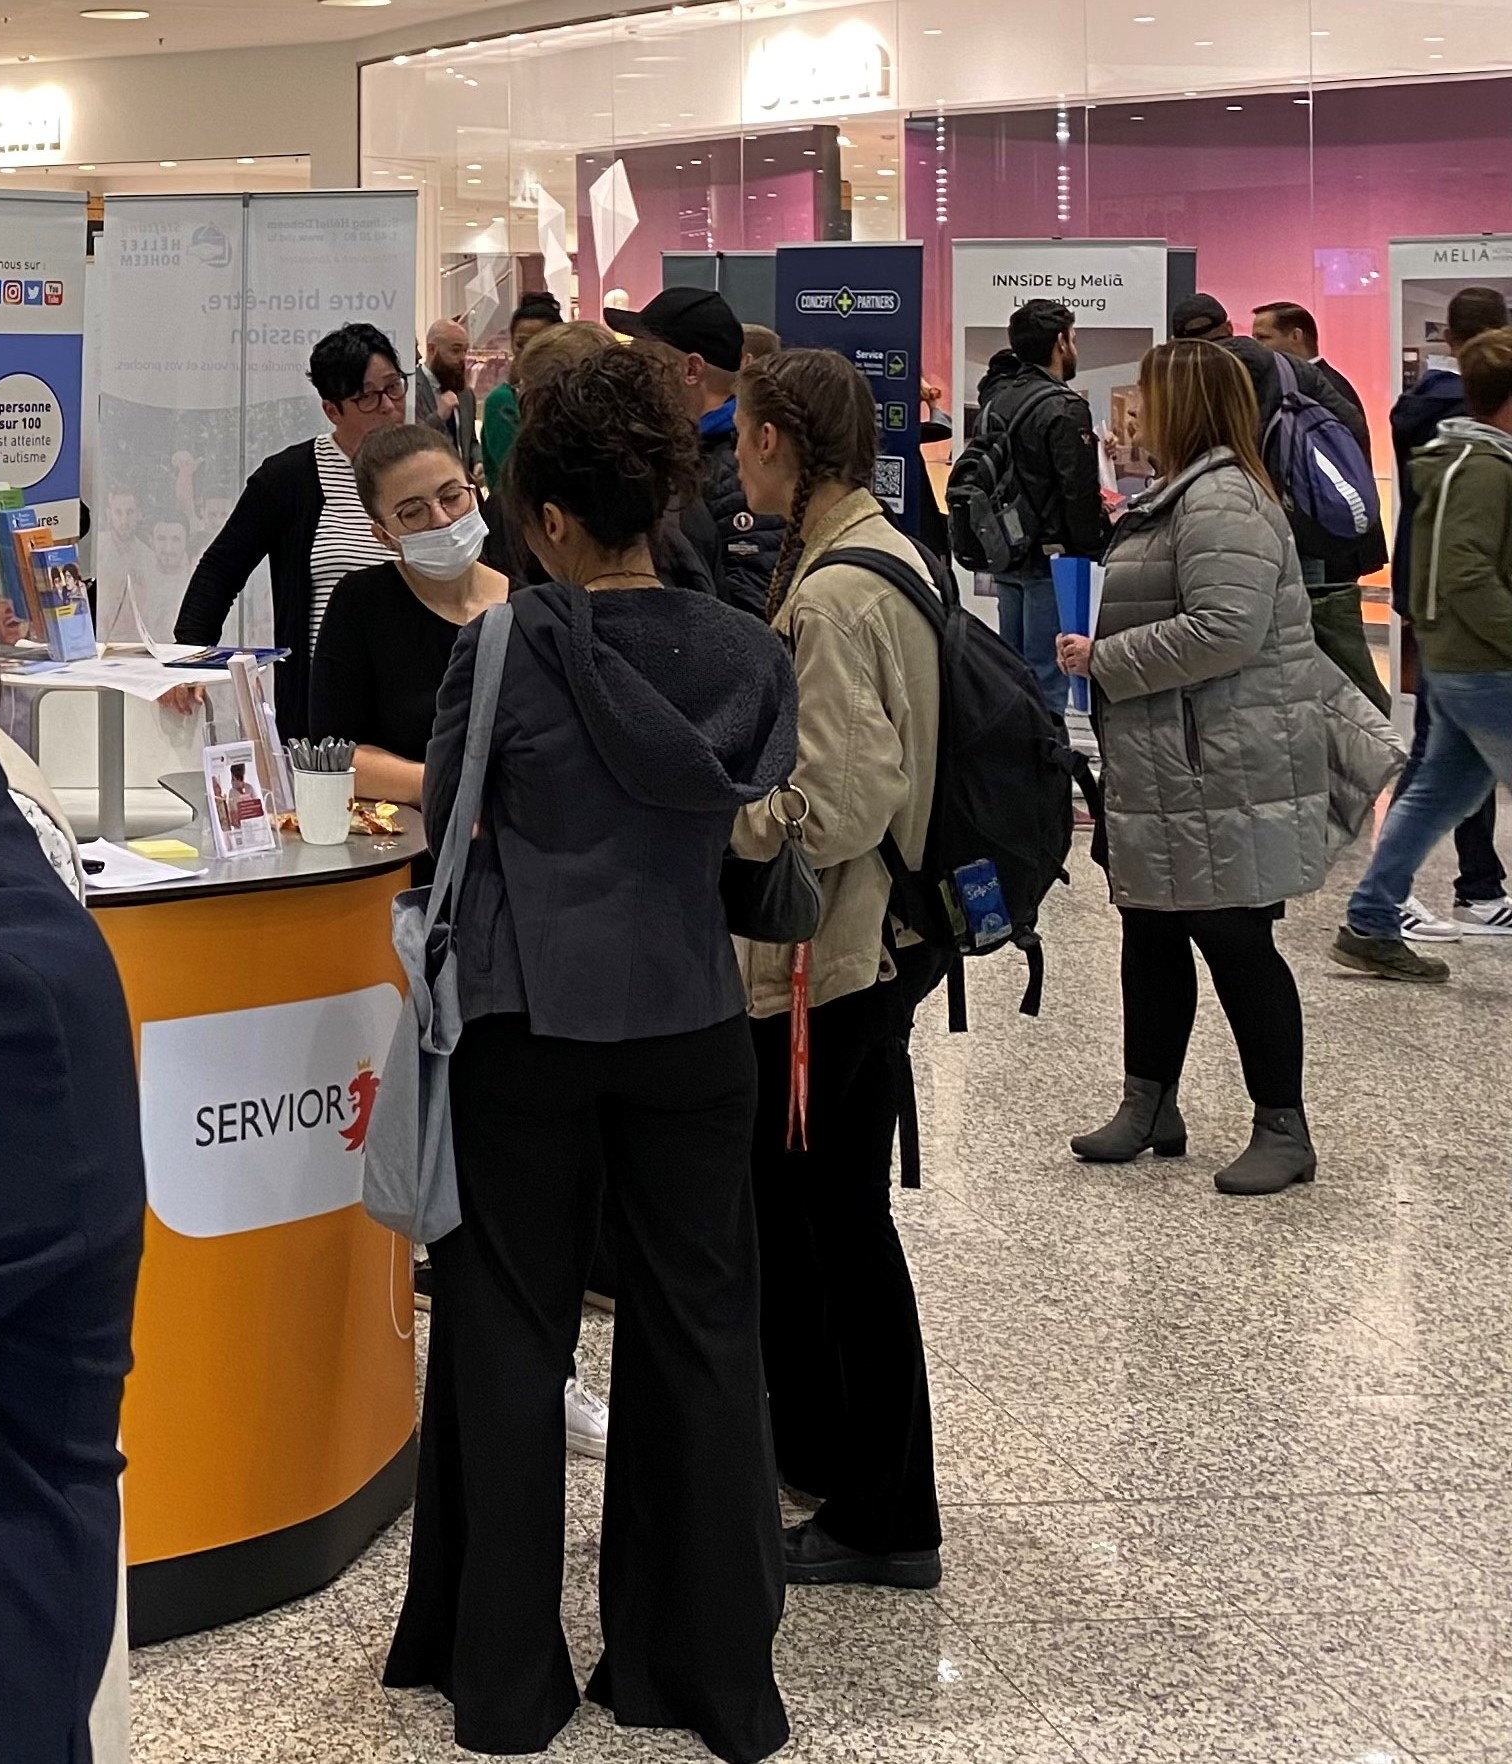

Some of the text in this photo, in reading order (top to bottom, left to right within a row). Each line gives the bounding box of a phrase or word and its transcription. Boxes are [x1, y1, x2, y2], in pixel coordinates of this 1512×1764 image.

[24, 261, 41, 270] sur
[1057, 275, 1076, 290] by
[801, 295, 895, 309] CONCEPT PARTNERS
[855, 350, 884, 359] Service
[22, 417, 42, 430] 100
[11, 434, 52, 447] atteinte
[195, 1084, 345, 1147] SERVIOR
